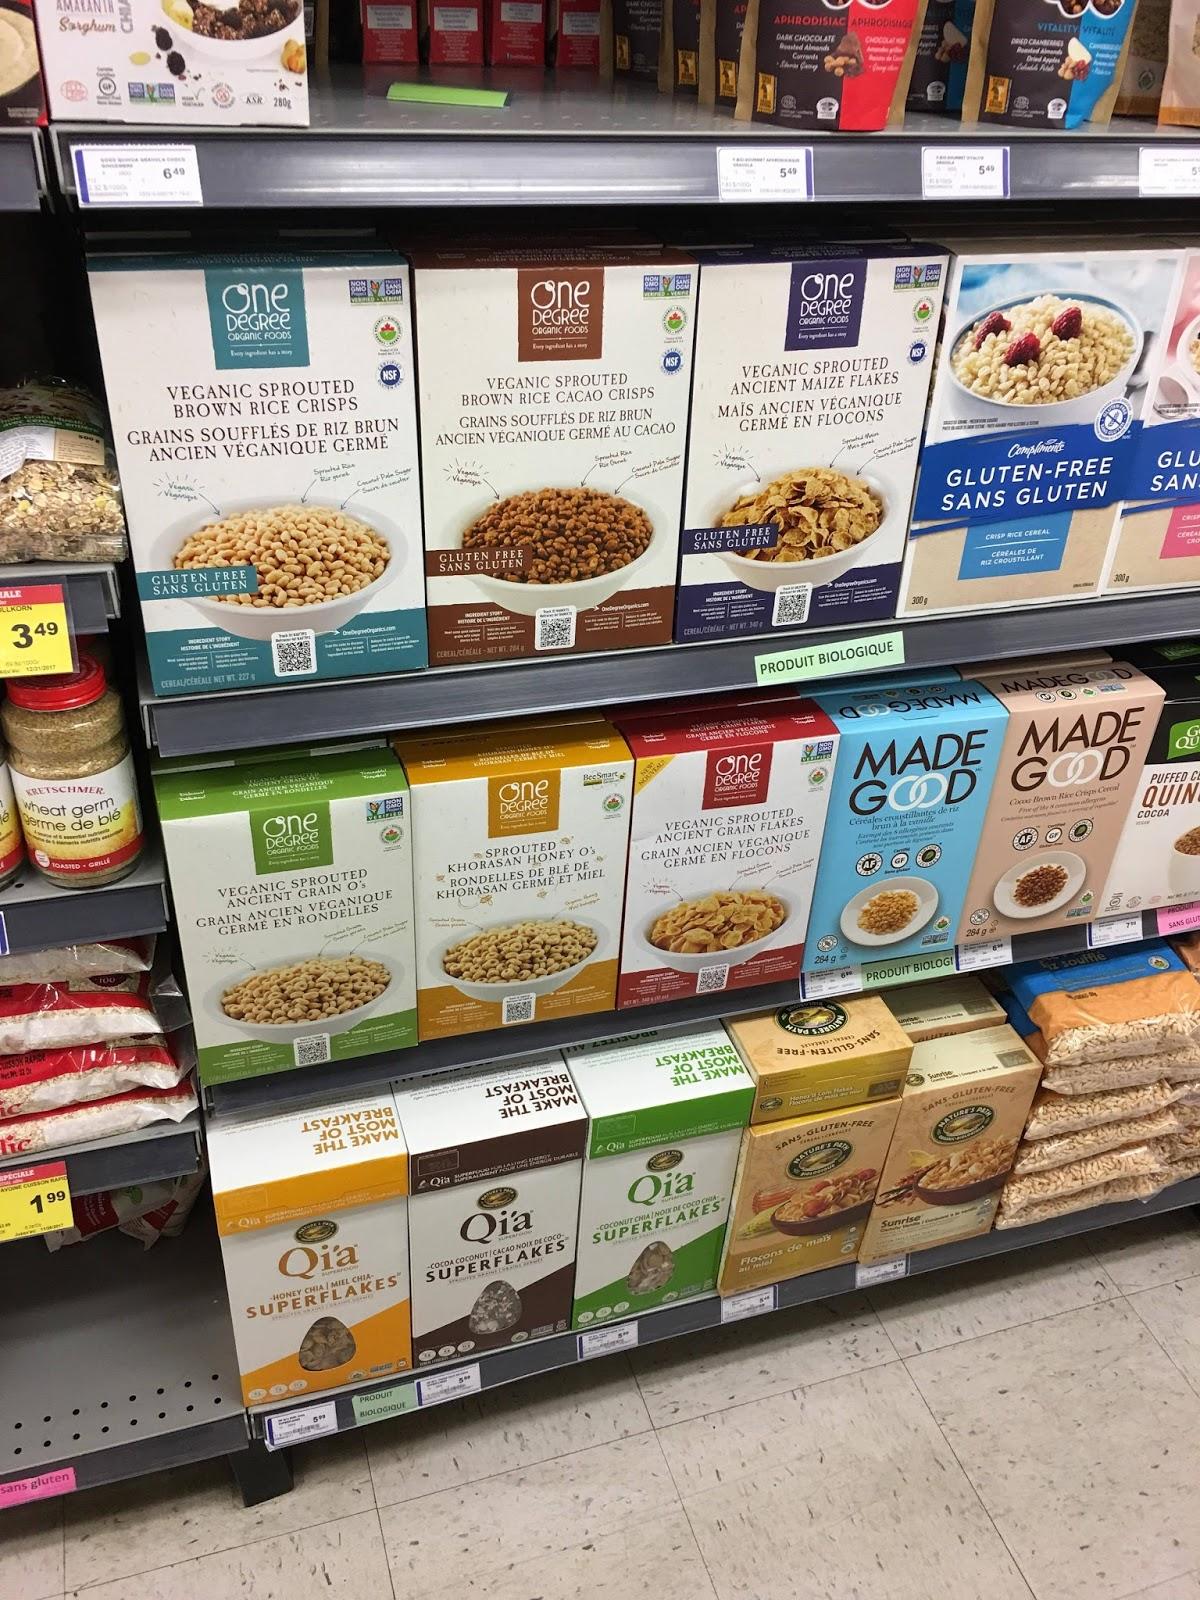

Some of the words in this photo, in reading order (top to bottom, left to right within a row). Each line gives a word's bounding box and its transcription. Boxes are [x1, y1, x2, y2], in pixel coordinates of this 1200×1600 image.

[59, 17, 116, 36] Sorghum
[774, 16, 846, 26] APHRODISIAC
[1038, 23, 1078, 32] VITALITY
[273, 97, 292, 109] 280g
[265, 331, 292, 340] FOODS
[383, 370, 397, 380] NSF
[742, 363, 808, 378] VEGANIC
[814, 357, 888, 375] SPROUTED
[167, 384, 252, 401] VEGANIC
[259, 380, 355, 397] SPROUTED
[487, 376, 550, 390] VEGANIC
[555, 373, 628, 388] SPROUTED
[731, 379, 796, 395] ANCIENT
[802, 376, 844, 390] MAIZE
[850, 371, 899, 387] FLAKES
[462, 393, 513, 406] BROWN
[520, 392, 550, 405] RICE
[556, 390, 603, 402] CACAO
[609, 387, 654, 400] CRISPS
[718, 403, 754, 418] MAÏS
[759, 400, 814, 415] ANCIEN
[820, 393, 902, 411] VÉGANIQUE
[173, 402, 242, 418] BROWN
[250, 400, 290, 415] RICE
[297, 396, 358, 413] CRISPS
[739, 414, 788, 432] GERMÉ
[794, 415, 811, 428] EN
[817, 410, 884, 426] FLOCONS
[127, 428, 194, 446] GRAINS
[201, 423, 289, 441] SOUFFLÉS
[296, 423, 318, 438] DE
[324, 421, 348, 435] RIZ
[355, 418, 399, 433] BRUN
[436, 432, 485, 445] ANCIEN
[489, 427, 565, 443] VÉGANIQUE
[569, 426, 610, 440] GERMÉ
[614, 426, 630, 437] AU
[634, 422, 676, 435] CACAO
[149, 446, 217, 462] ANCIEN
[223, 440, 327, 458] VÉGANIQUE
[333, 433, 389, 452] GERMÉ
[1007, 440, 1066, 458] Compliments
[946, 457, 1113, 487] GLUTEN-FREE
[941, 490, 1005, 511] SANS
[1016, 481, 1107, 504] GLUTEN
[986, 532, 1005, 540] CRISP
[1007, 530, 1022, 538] RICE
[994, 554, 1043, 564] CROUSTILLANT
[152, 572, 207, 585] GLUTEN
[215, 570, 247, 581] FREE
[153, 584, 188, 596] SANS
[194, 581, 247, 592] GLUTEN
[912, 596, 923, 604] 300
[342, 626, 396, 636] OneDegreeOrganics.com
[760, 655, 815, 674] PRODUIT
[819, 641, 893, 665] BIOLOGIQUE
[1017, 706, 1145, 757] MADE
[853, 729, 989, 779] MADE
[583, 771, 619, 781] BeeSmart
[1011, 746, 1130, 792] GOOD
[1150, 772, 1187, 784] PUFFED
[26, 786, 104, 796] KRETSCHMER
[849, 769, 977, 816] GOOD
[1033, 794, 1056, 802] Brown
[1098, 784, 1120, 793] Cereal
[22, 800, 66, 816] wheat
[72, 797, 114, 818] germ
[1137, 810, 1169, 819] COCOA
[23, 813, 65, 831] germe
[71, 819, 93, 830] de
[98, 808, 120, 826] blé
[655, 829, 713, 844] ANCIENT
[717, 824, 756, 837] GRAIN
[760, 817, 804, 831] FLAKES
[486, 841, 556, 858] SPROUTED
[448, 856, 522, 873] KHORASAN
[527, 849, 574, 864] HONEY
[218, 881, 286, 898] VEGANIC
[291, 868, 368, 888] SPROUTED
[437, 883, 508, 899] KHORASAN
[559, 874, 573, 884] ET
[577, 869, 605, 882] MIEL
[227, 892, 293, 908] ANCIENT
[298, 884, 342, 899] GRAIN
[274, 919, 292, 928] EN
[298, 903, 379, 924] RONDELLES
[1168, 903, 1193, 914] PRODUIT
[1169, 920, 1184, 928] SANS
[814, 955, 829, 964] 284
[831, 955, 836, 964] g
[866, 965, 910, 982] PRODUIT
[914, 956, 953, 971] BIOLOGI
[485, 1074, 570, 1098] BREAKFAST
[529, 1084, 573, 1100] MOST
[503, 1095, 524, 1106] OF
[535, 1094, 578, 1112] MAKE
[499, 1104, 530, 1119] THE
[23, 1180, 50, 1189] CUISSON
[592, 1200, 721, 1244] SUPERFLAKES
[881, 1214, 922, 1228] Sunrise
[455, 1252, 489, 1264] COCONUT
[493, 1245, 515, 1255] CACAO
[516, 1241, 533, 1250] NOIX
[534, 1238, 542, 1246] DE
[740, 1248, 784, 1266] Flocons
[787, 1243, 803, 1252] de
[426, 1239, 565, 1283] SUPERFLAKES
[246, 1274, 397, 1319] SUPERFLAKES
[359, 1390, 393, 1403] PRODUIT
[360, 1402, 407, 1417] BIOLOGIQUE
[1, 1484, 27, 1494] sans
[30, 1474, 69, 1489] gluten
